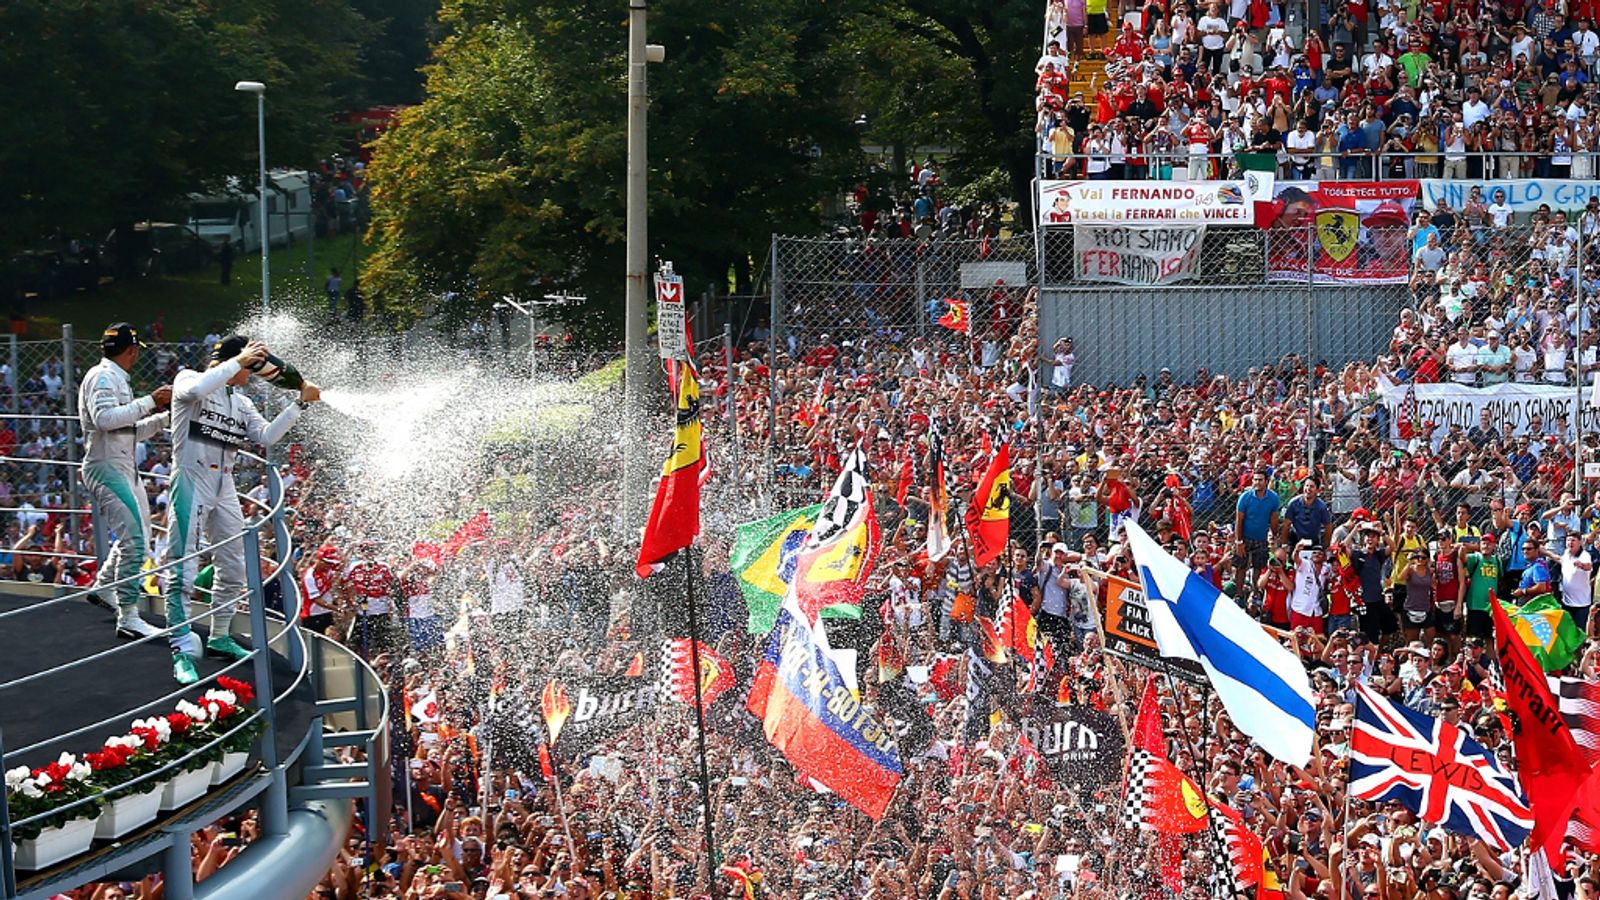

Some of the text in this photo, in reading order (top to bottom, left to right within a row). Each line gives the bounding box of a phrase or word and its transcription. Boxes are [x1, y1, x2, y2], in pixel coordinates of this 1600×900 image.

[1080, 188, 1103, 200] Vai
[1112, 188, 1195, 200] FERNANDO
[1427, 182, 1463, 208] UN
[1074, 209, 1088, 220] Tu
[1092, 209, 1108, 220] sei
[1126, 209, 1177, 219] FERRARI
[1180, 209, 1200, 220] che
[1203, 209, 1239, 219] VINCE
[1138, 229, 1198, 251] SIAMO
[1487, 398, 1522, 430] IAMO
[1126, 606, 1142, 620] FIA
[1062, 751, 1097, 762] DRINK
[1390, 747, 1483, 790] LEWIS
